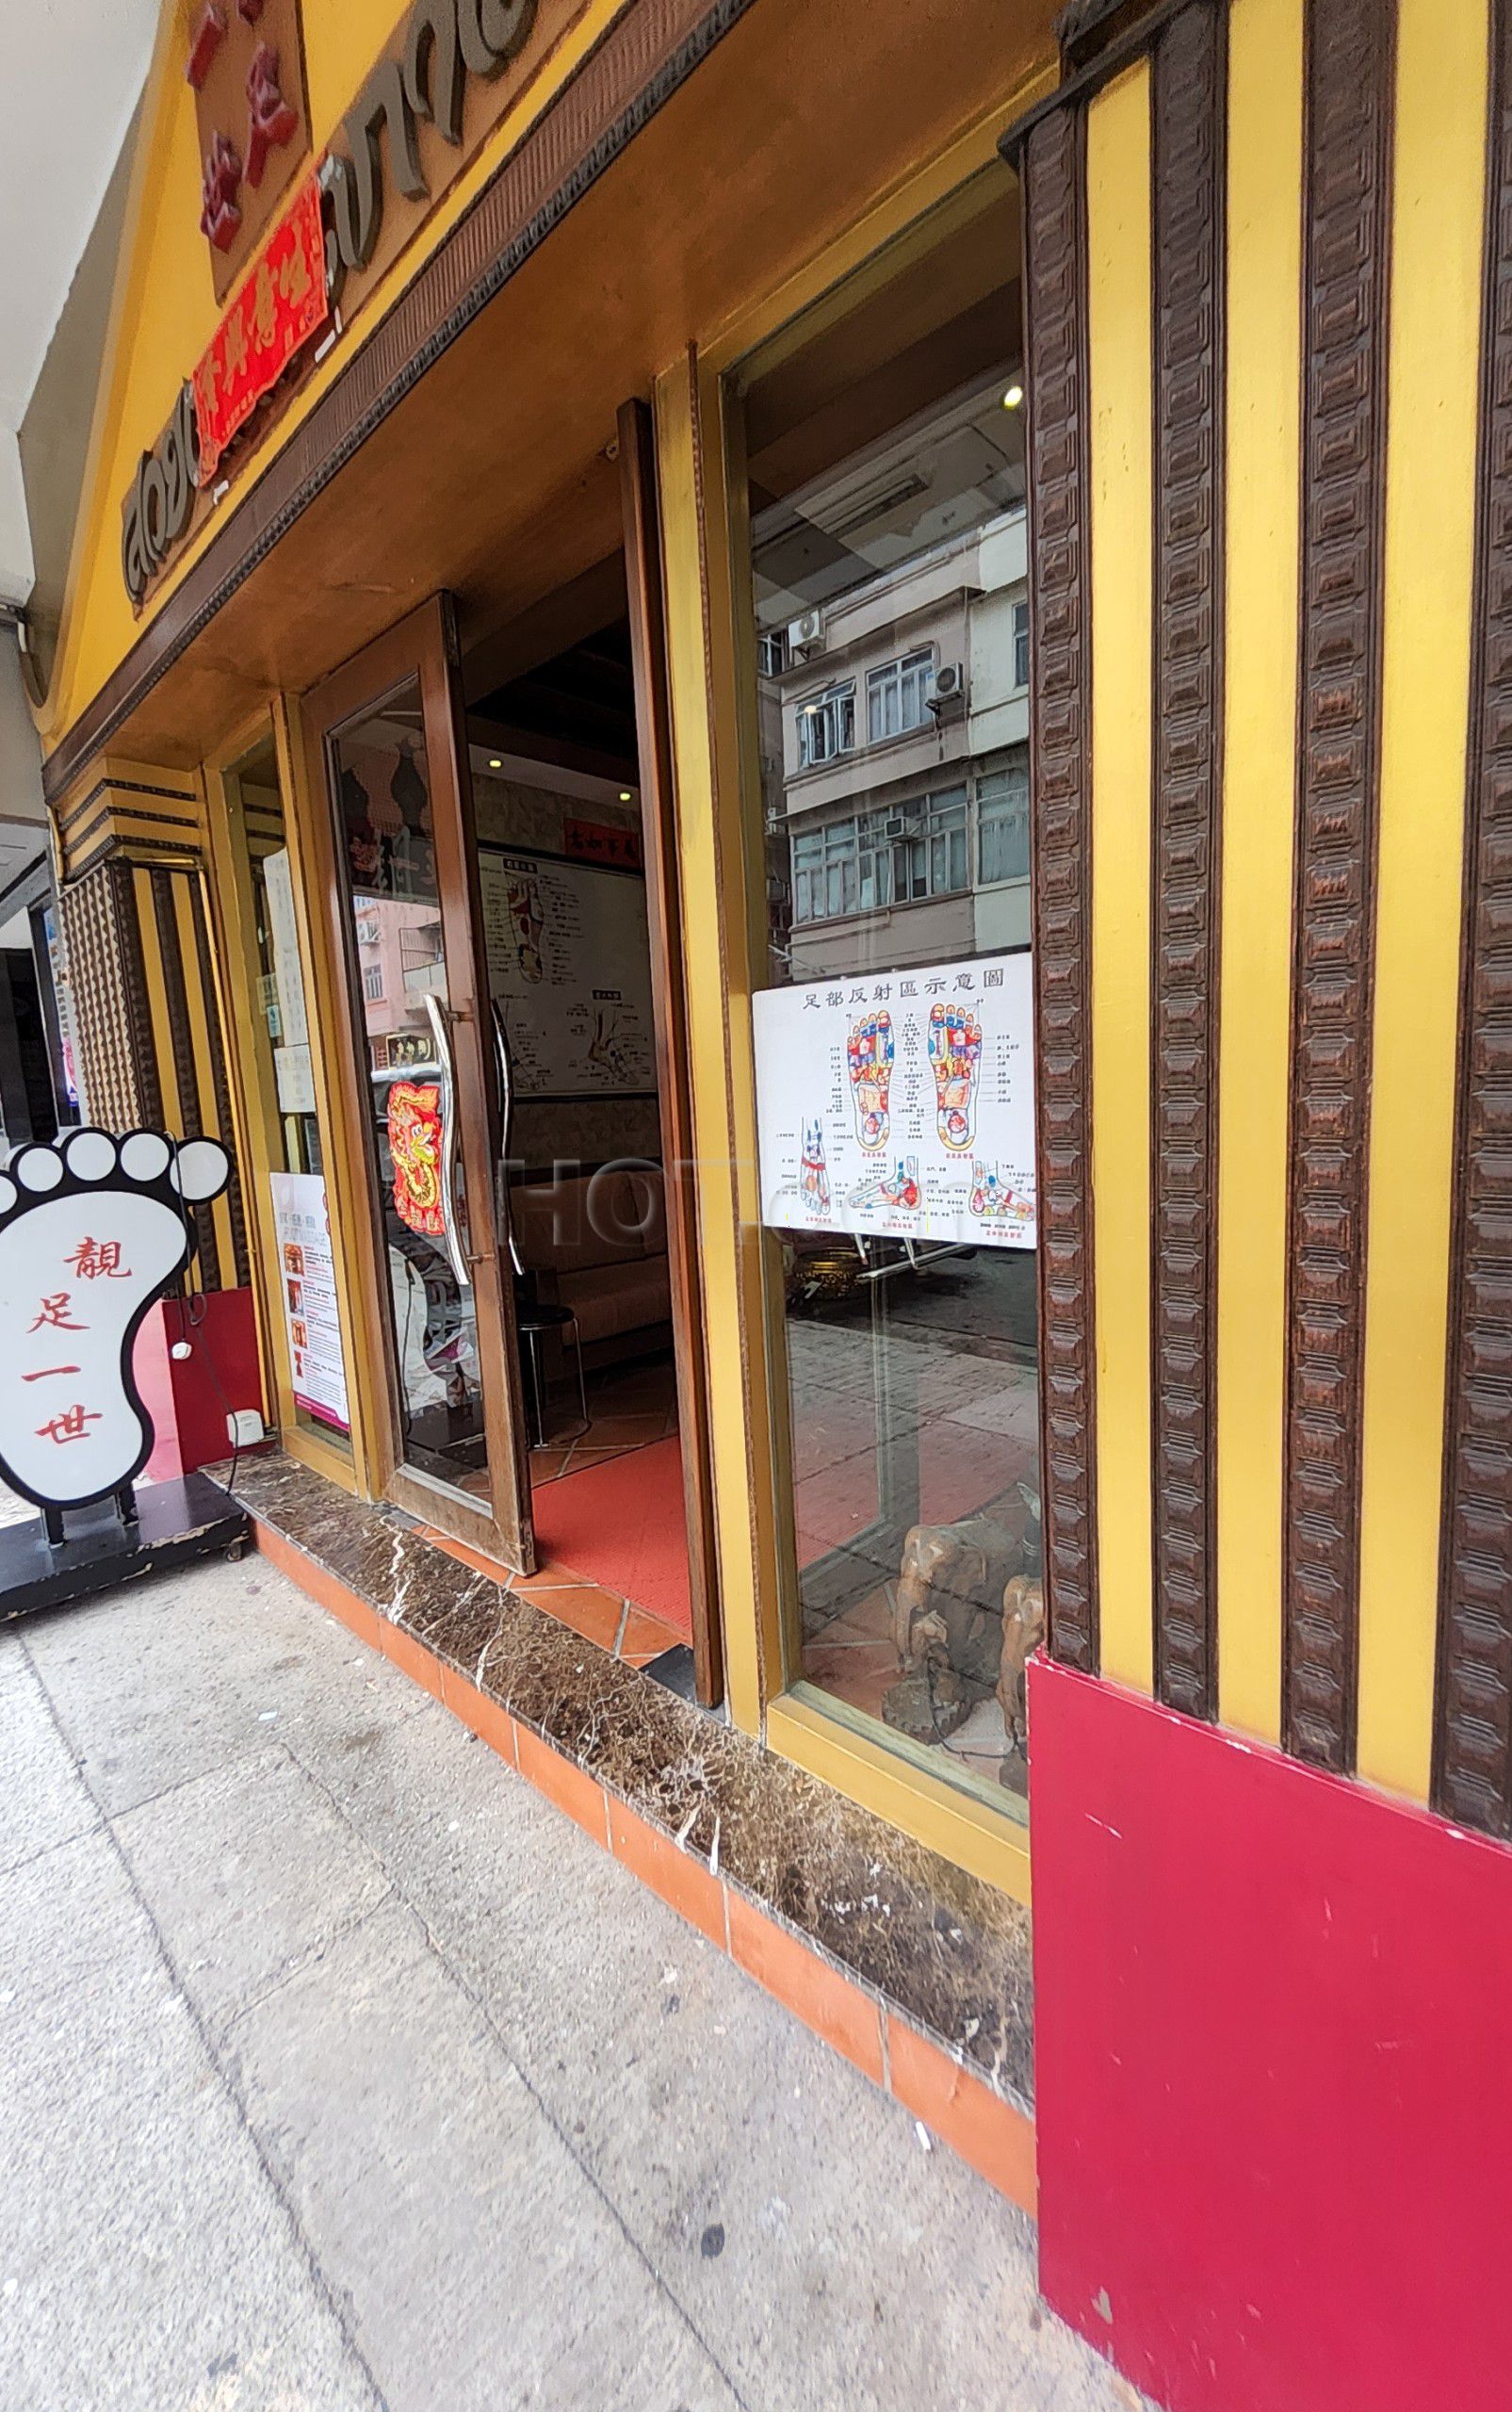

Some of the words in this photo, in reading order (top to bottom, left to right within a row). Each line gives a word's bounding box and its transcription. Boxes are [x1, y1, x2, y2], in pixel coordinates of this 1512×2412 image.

[803, 969, 1004, 1010] 足部反射區示意圖
[21, 1235, 133, 1444] 靚足一世
